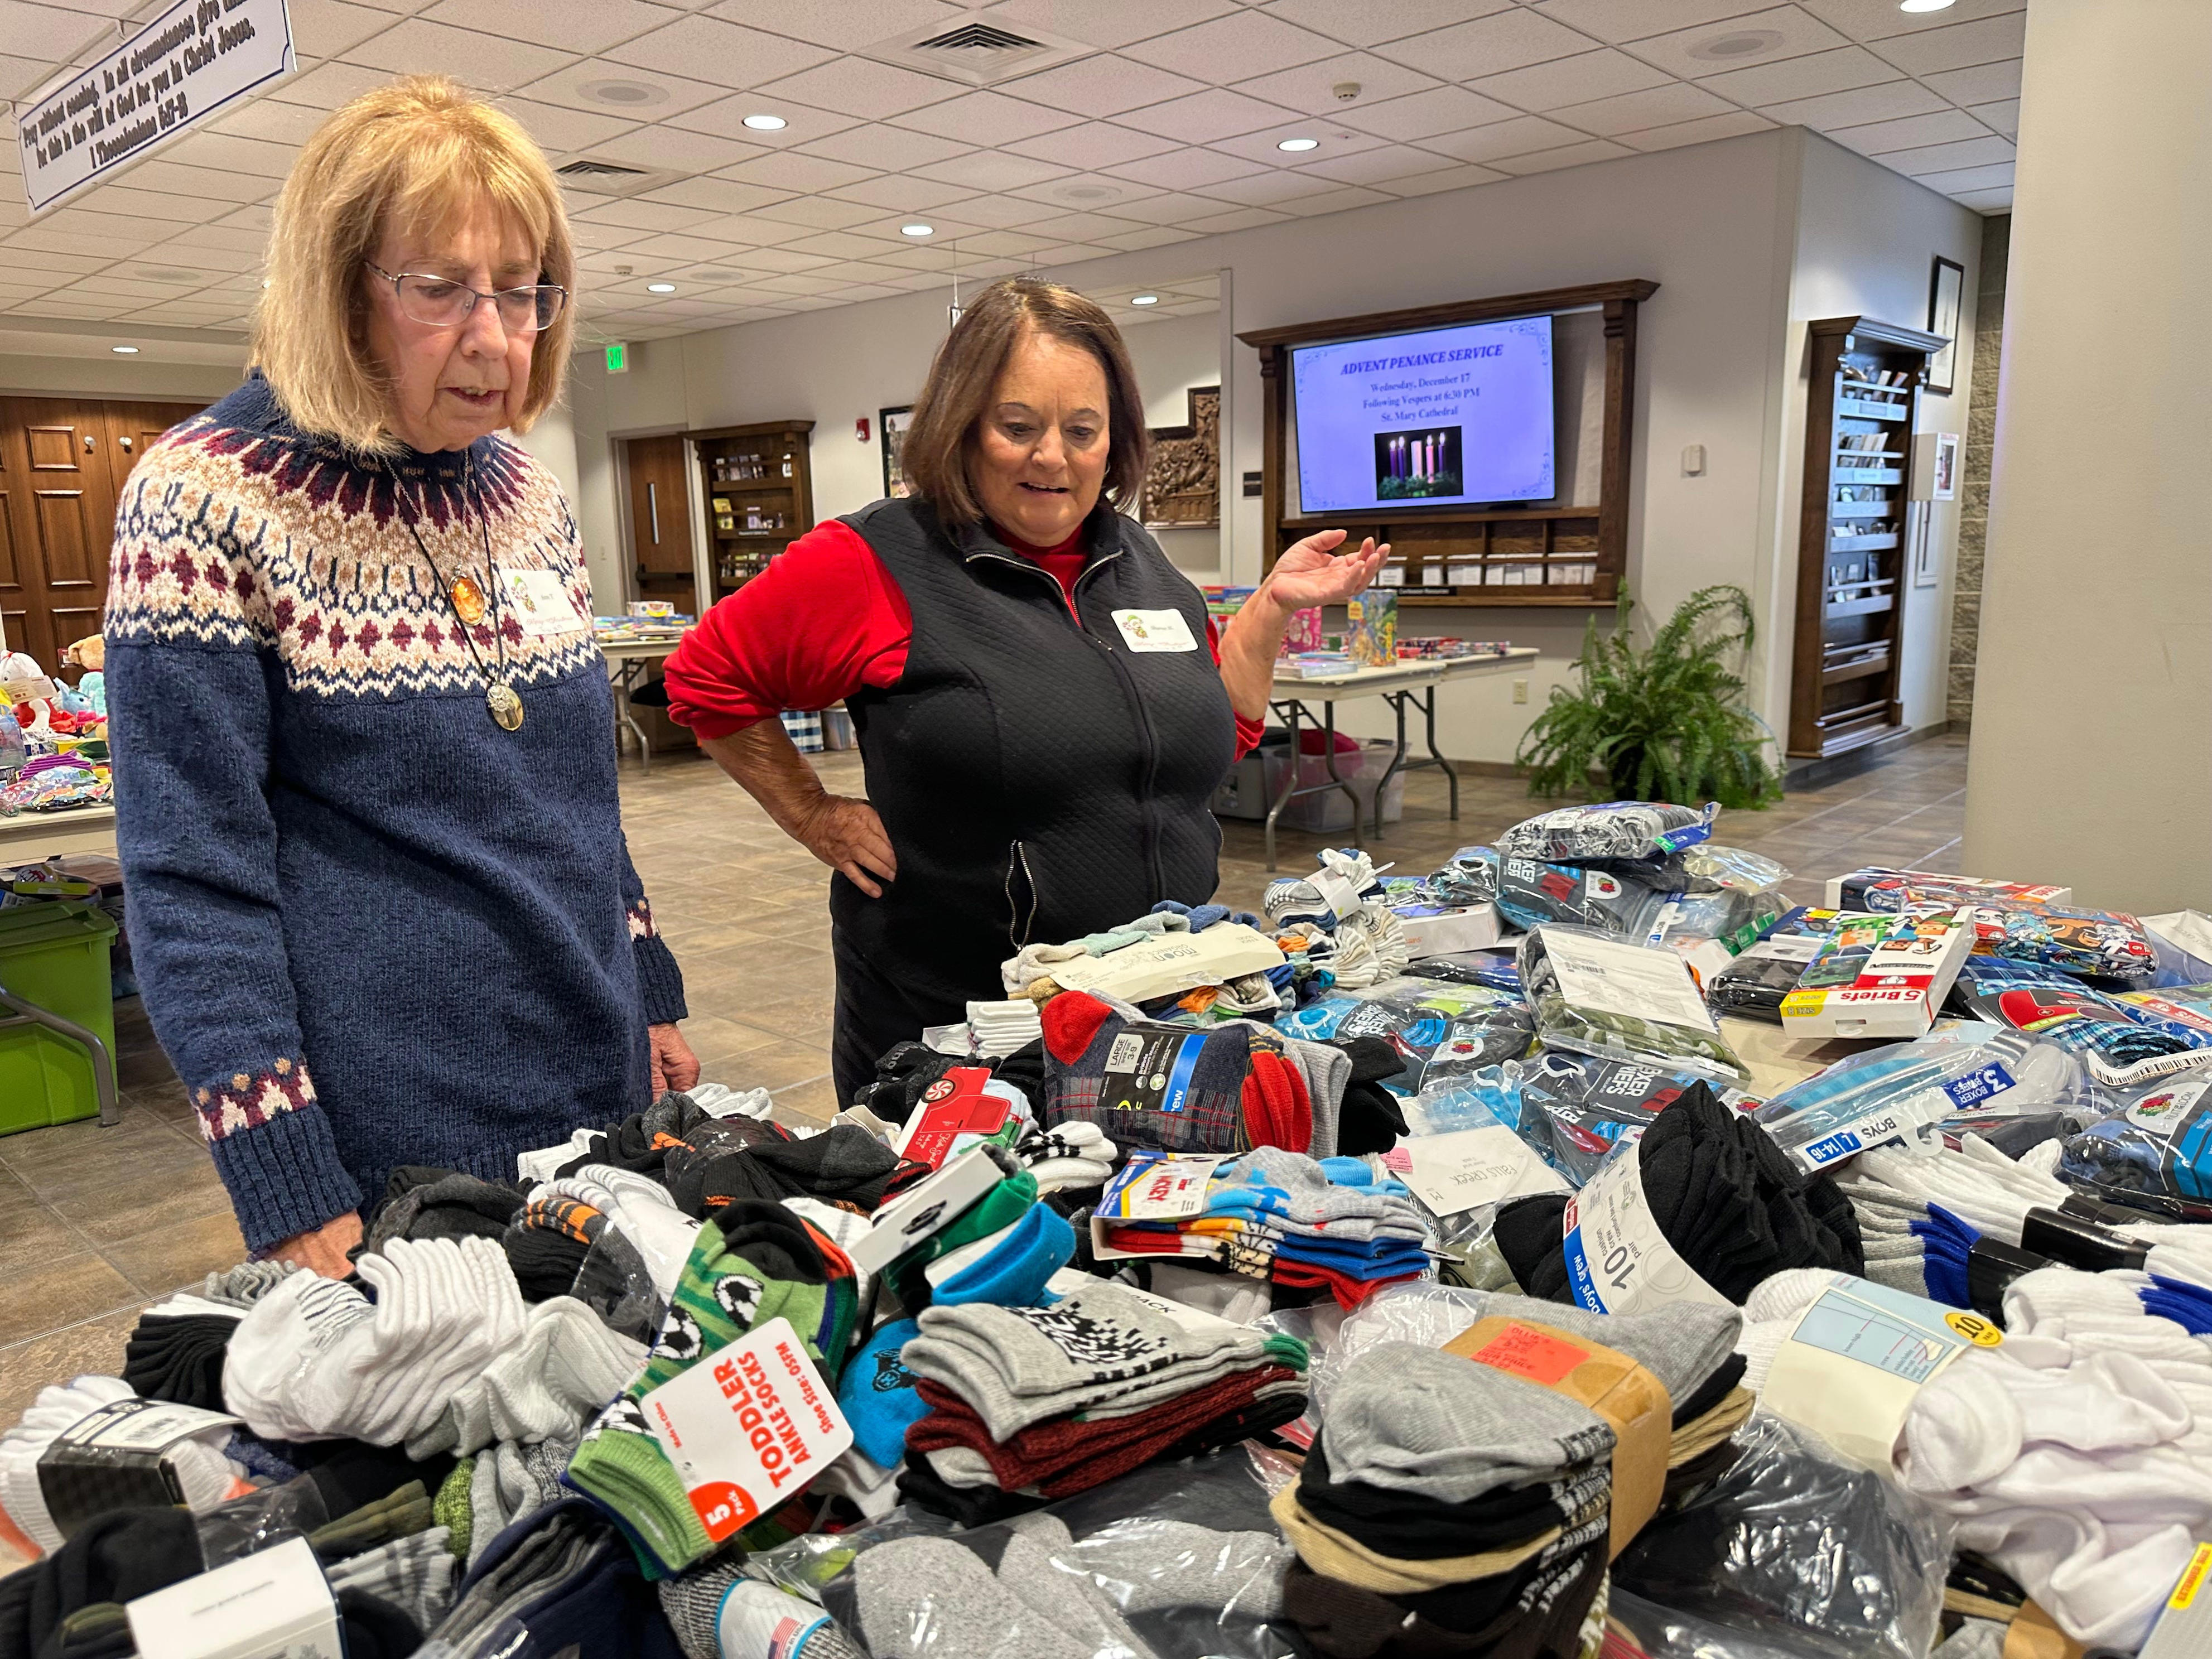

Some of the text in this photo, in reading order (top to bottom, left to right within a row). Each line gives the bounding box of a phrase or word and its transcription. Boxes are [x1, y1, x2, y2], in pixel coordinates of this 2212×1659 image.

[38, 101, 66, 137] without
[103, 70, 115, 94] In
[117, 56, 129, 86] all
[130, 15, 195, 76] circumstances
[197, 0, 220, 36] give
[37, 18, 255, 169] for this is the will of God for you in Christ Jesus.
[96, 116, 157, 165] Thessalonians
[1341, 344, 1503, 375] ADVENT PENANCE SERVICE
[1371, 373, 1470, 392] Wednesday, December 17
[1363, 388, 1480, 408] Following Vespers at 6:30 PM
[1381, 406, 1458, 422] St. Mary Cathedral
[1154, 947, 1197, 962] moon
[1841, 990, 1921, 1001] 5 Briefs
[1787, 1007, 1795, 1015] 8
[1110, 1039, 1126, 1065] LARGE
[1127, 1046, 1137, 1060] 3-9
[1983, 1069, 2008, 1093] 3
[1171, 1089, 1184, 1112] ew
[1960, 1084, 1989, 1104] BOXER
[1861, 1117, 1897, 1140] BOYS
[936, 1133, 951, 1149] Kids
[1810, 1135, 1854, 1160] L 14-16
[1429, 1191, 1444, 1201] M
[1611, 1214, 1622, 1237] comfort
[1596, 1228, 1608, 1256] cushion
[1607, 1229, 1616, 1249] crew
[1628, 1241, 1642, 1259] pair
[1573, 1255, 1587, 1282] crew
[1604, 1246, 1636, 1290] 10
[1954, 1316, 1985, 1339] 10
[1982, 1331, 1994, 1342] PAIR
[774, 1341, 835, 1434] Shoe Size: OSFM
[737, 1351, 812, 1465] ANKLE SOCKS
[655, 1401, 682, 1449] Made in China
[714, 1357, 793, 1489] TODDLER
[727, 1489, 746, 1516] Pack
[705, 1503, 731, 1527] 5
